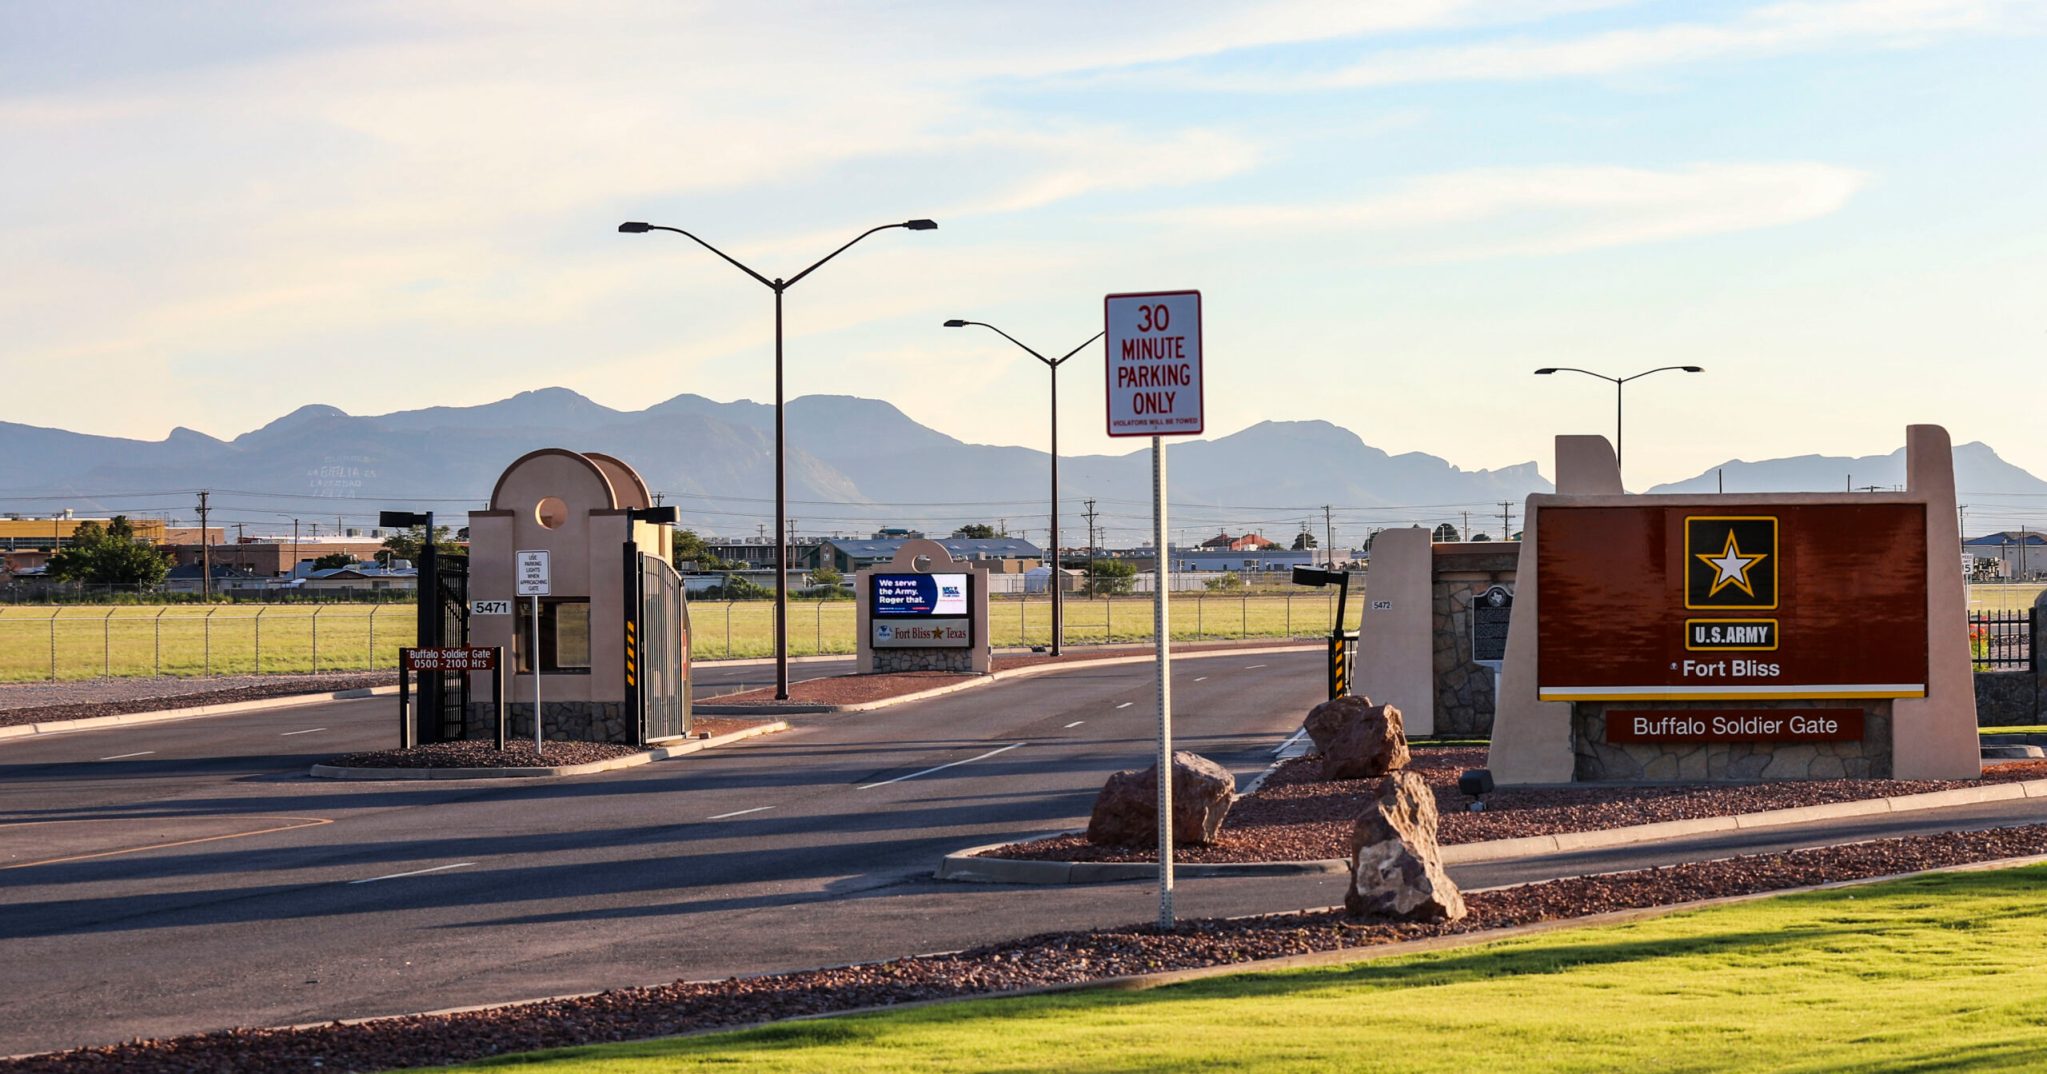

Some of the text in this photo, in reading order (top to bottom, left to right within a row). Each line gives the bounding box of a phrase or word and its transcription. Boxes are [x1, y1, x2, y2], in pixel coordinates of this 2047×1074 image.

[1137, 304, 1169, 332] 30
[1122, 336, 1185, 360] MINUTE
[1118, 363, 1190, 388] PARKING
[1133, 391, 1176, 415] ONLY
[879, 579, 893, 587] We
[894, 588, 919, 596] Army.
[905, 596, 925, 604] that.
[1374, 601, 1391, 609] 5472
[476, 602, 507, 613] 5471
[895, 627, 967, 639] Fort Bliss Texas
[1695, 626, 1768, 643] U.S.ARMY
[410, 649, 491, 659] Buffalo Soldier Gate
[414, 660, 438, 668] 0500
[446, 660, 468, 668] 2100
[471, 660, 487, 668] Hrs
[1683, 659, 1780, 677] Fort Bliss
[1633, 715, 1838, 735] Buffalo Soldier Gate
